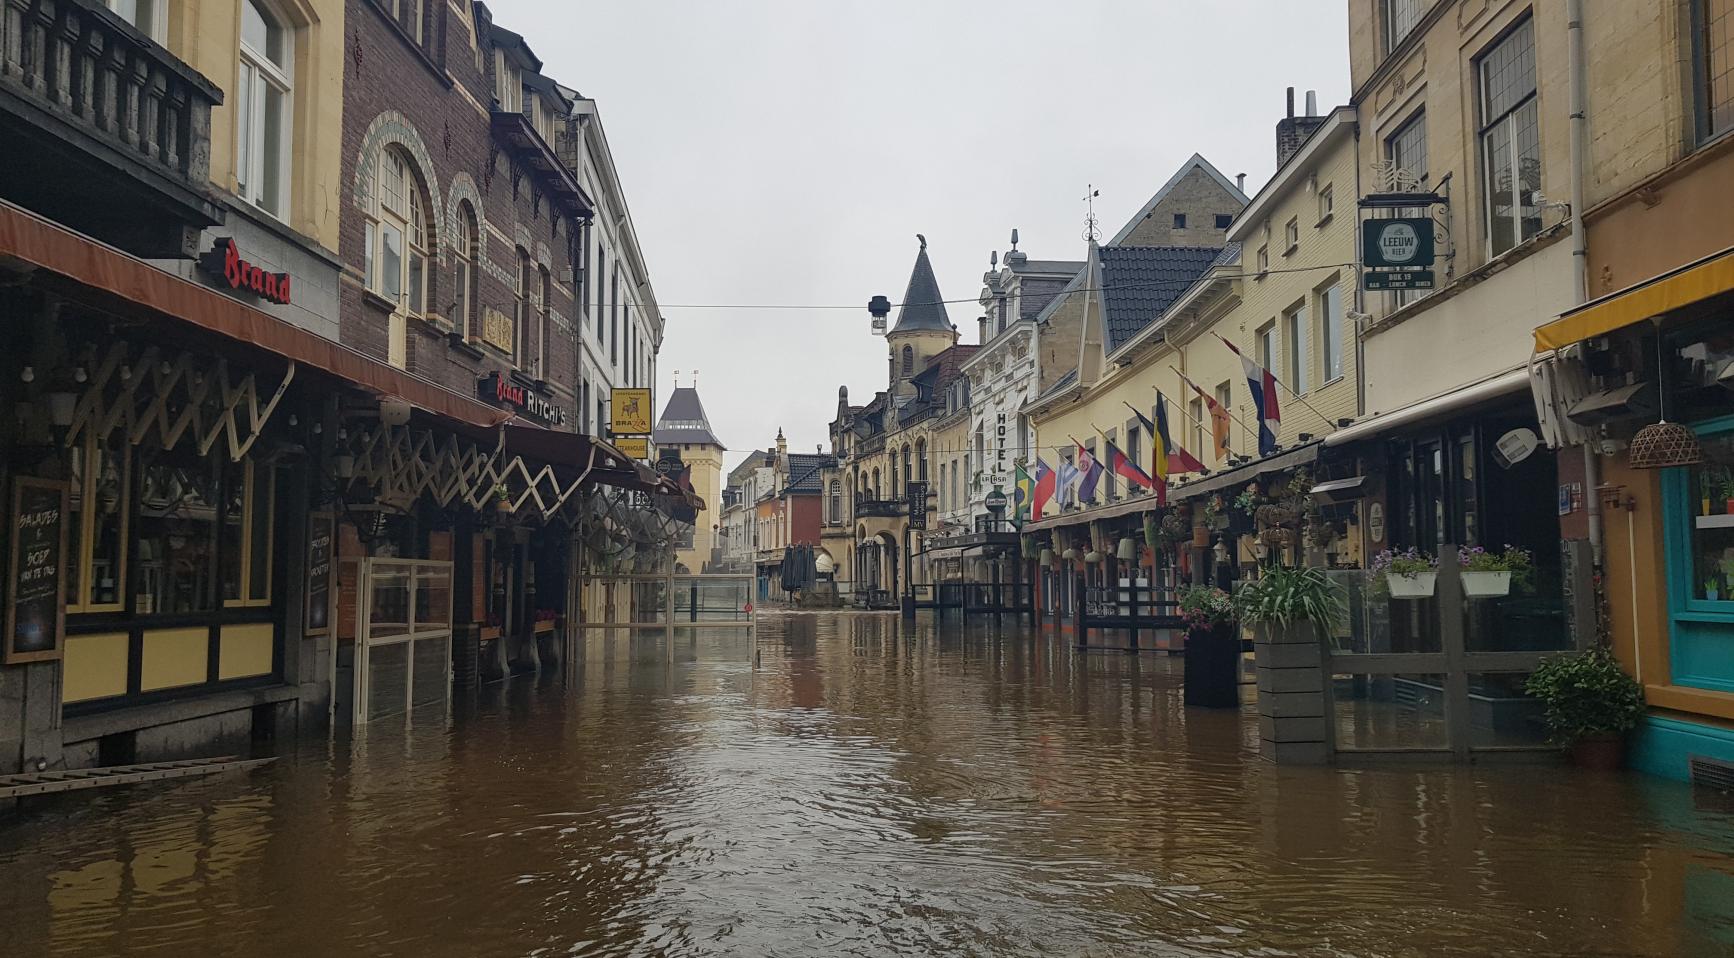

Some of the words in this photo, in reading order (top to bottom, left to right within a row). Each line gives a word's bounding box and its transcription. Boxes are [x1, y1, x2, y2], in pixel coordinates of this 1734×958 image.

[1384, 237, 1413, 247] LEEUW
[225, 239, 290, 304] Brand
[497, 370, 523, 406] Brand
[527, 390, 566, 426] RITCHI'S
[615, 419, 647, 432] BRAZZA
[997, 413, 1006, 473] HOTEL
[991, 475, 1007, 484] CASA
[19, 510, 59, 529] SALADES
[27, 548, 51, 568] SOEP
